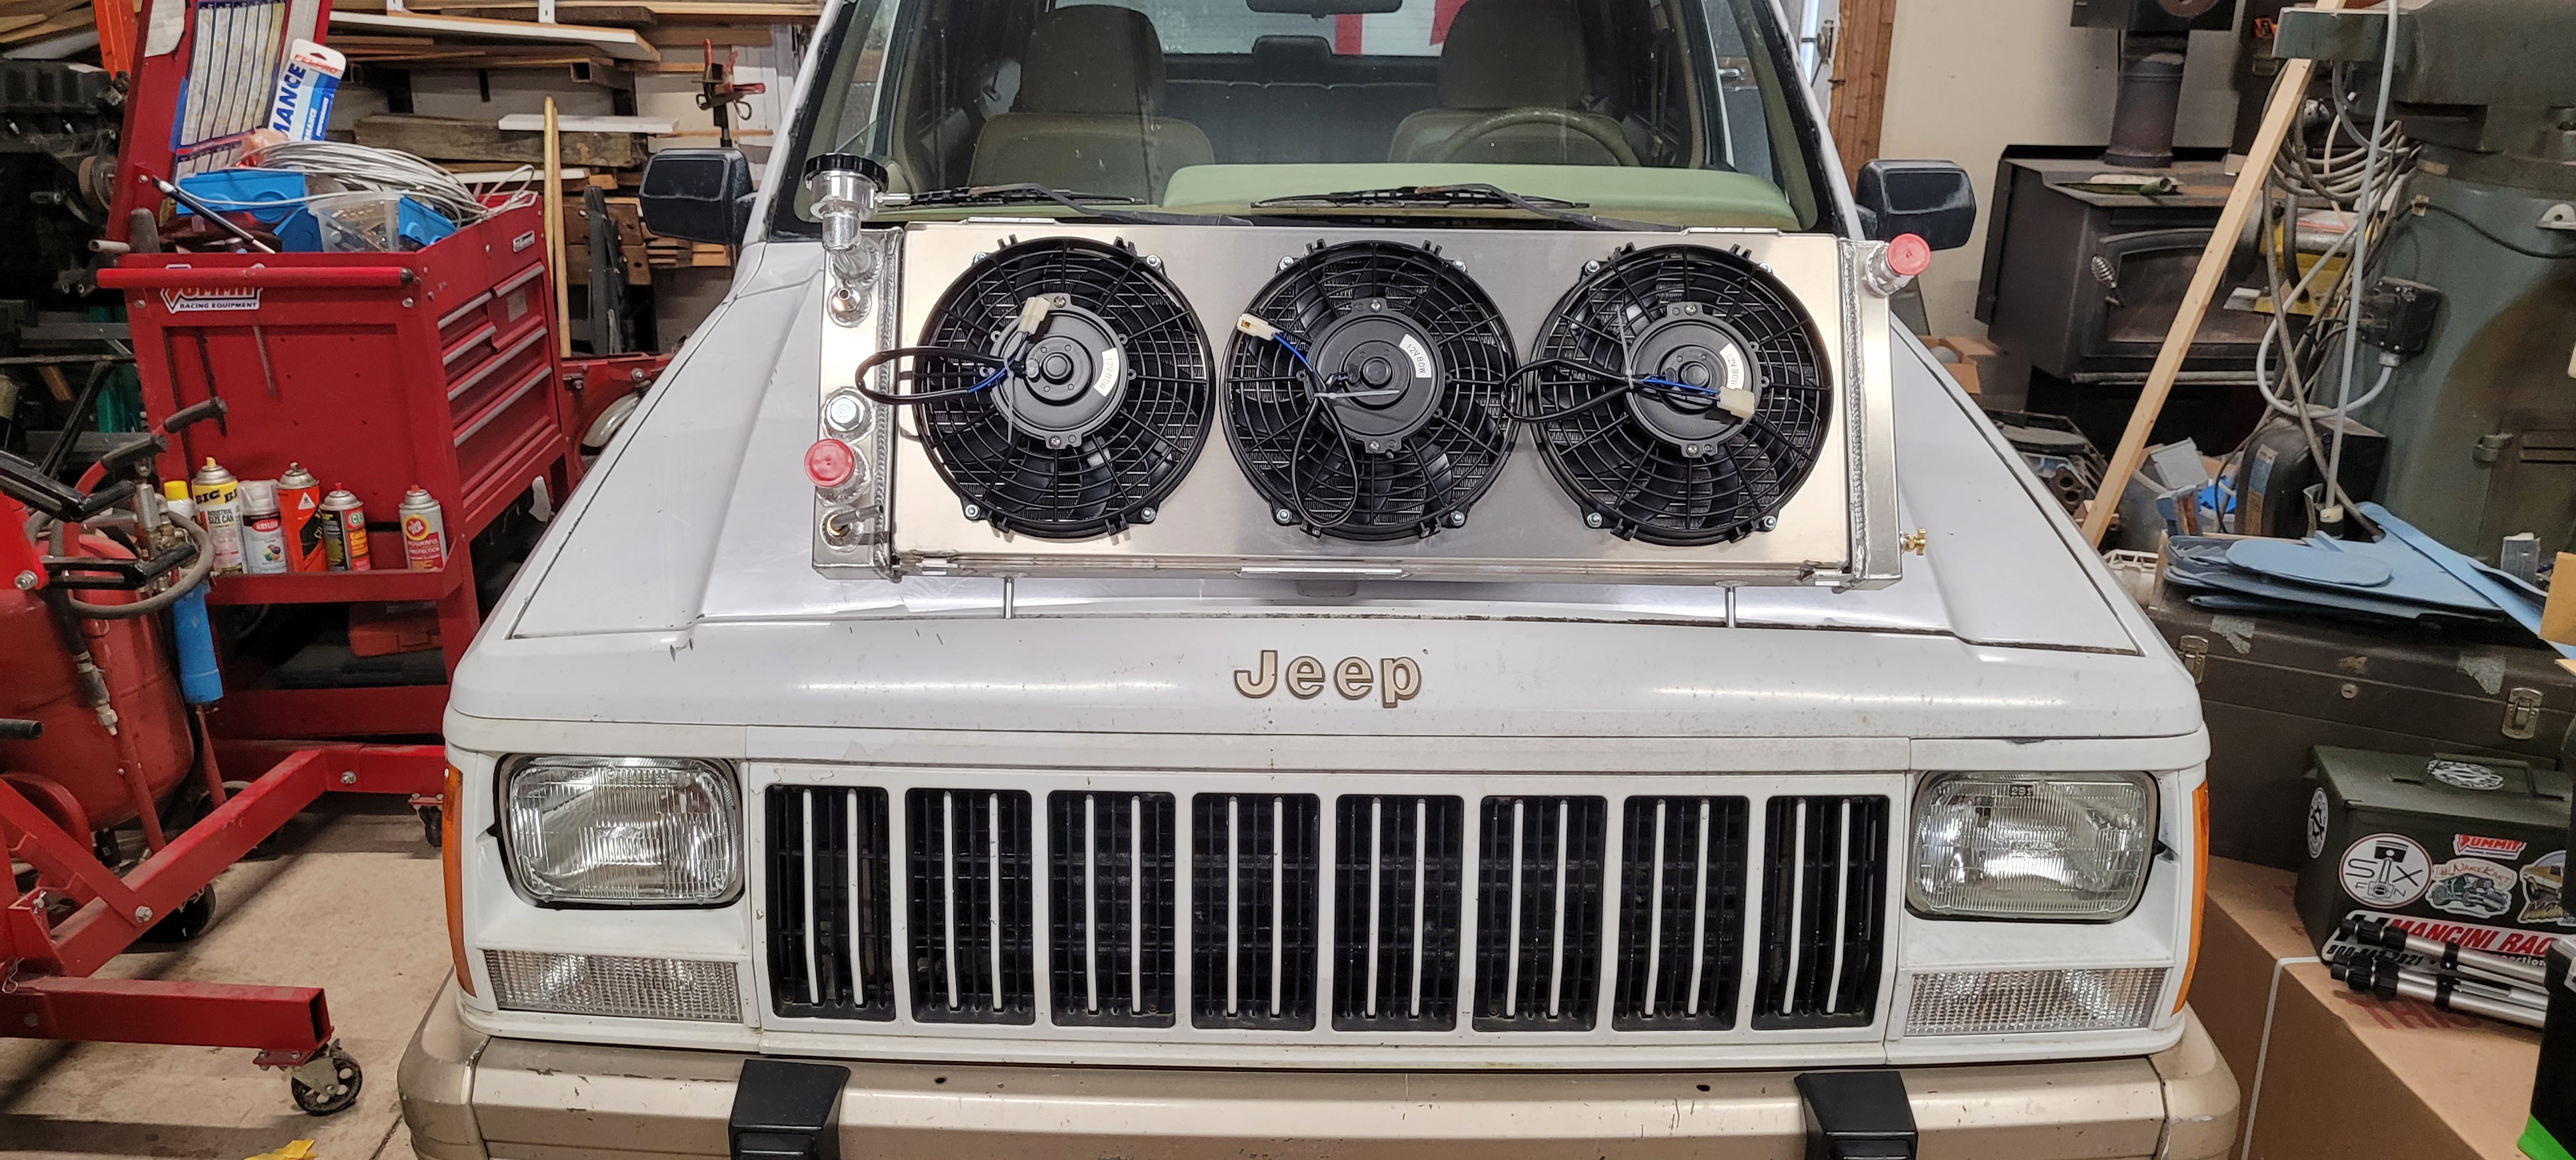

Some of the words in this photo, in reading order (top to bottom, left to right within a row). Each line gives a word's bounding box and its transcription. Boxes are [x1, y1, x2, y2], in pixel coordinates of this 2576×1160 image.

[1407, 344, 1420, 356] 12V
[1416, 356, 1426, 373] 80W
[1100, 373, 1112, 390] 80W
[195, 489, 220, 505] BIG
[208, 516, 221, 524] SIZE
[222, 515, 234, 523] CAN
[256, 521, 279, 530] KRYLON
[1234, 650, 1422, 708] Jeep
[2391, 919, 2500, 949] MANCINI
